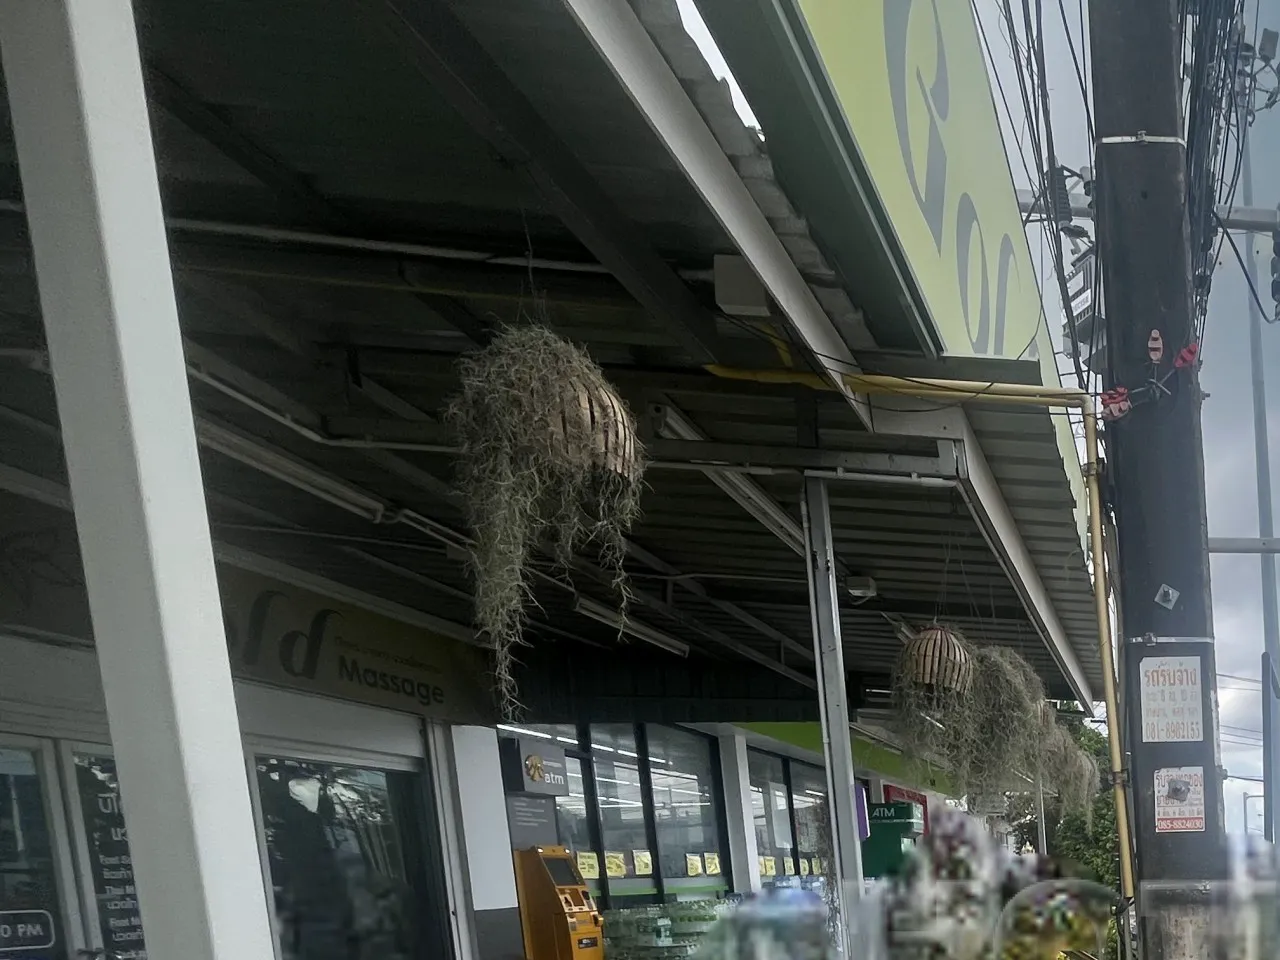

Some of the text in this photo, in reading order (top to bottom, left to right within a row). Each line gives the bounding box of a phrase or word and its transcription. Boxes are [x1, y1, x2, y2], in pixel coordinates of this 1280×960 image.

[338, 655, 445, 706] Massage
[544, 772, 565, 785] atm
[872, 807, 895, 817] ATM
[17, 923, 44, 937] PM
